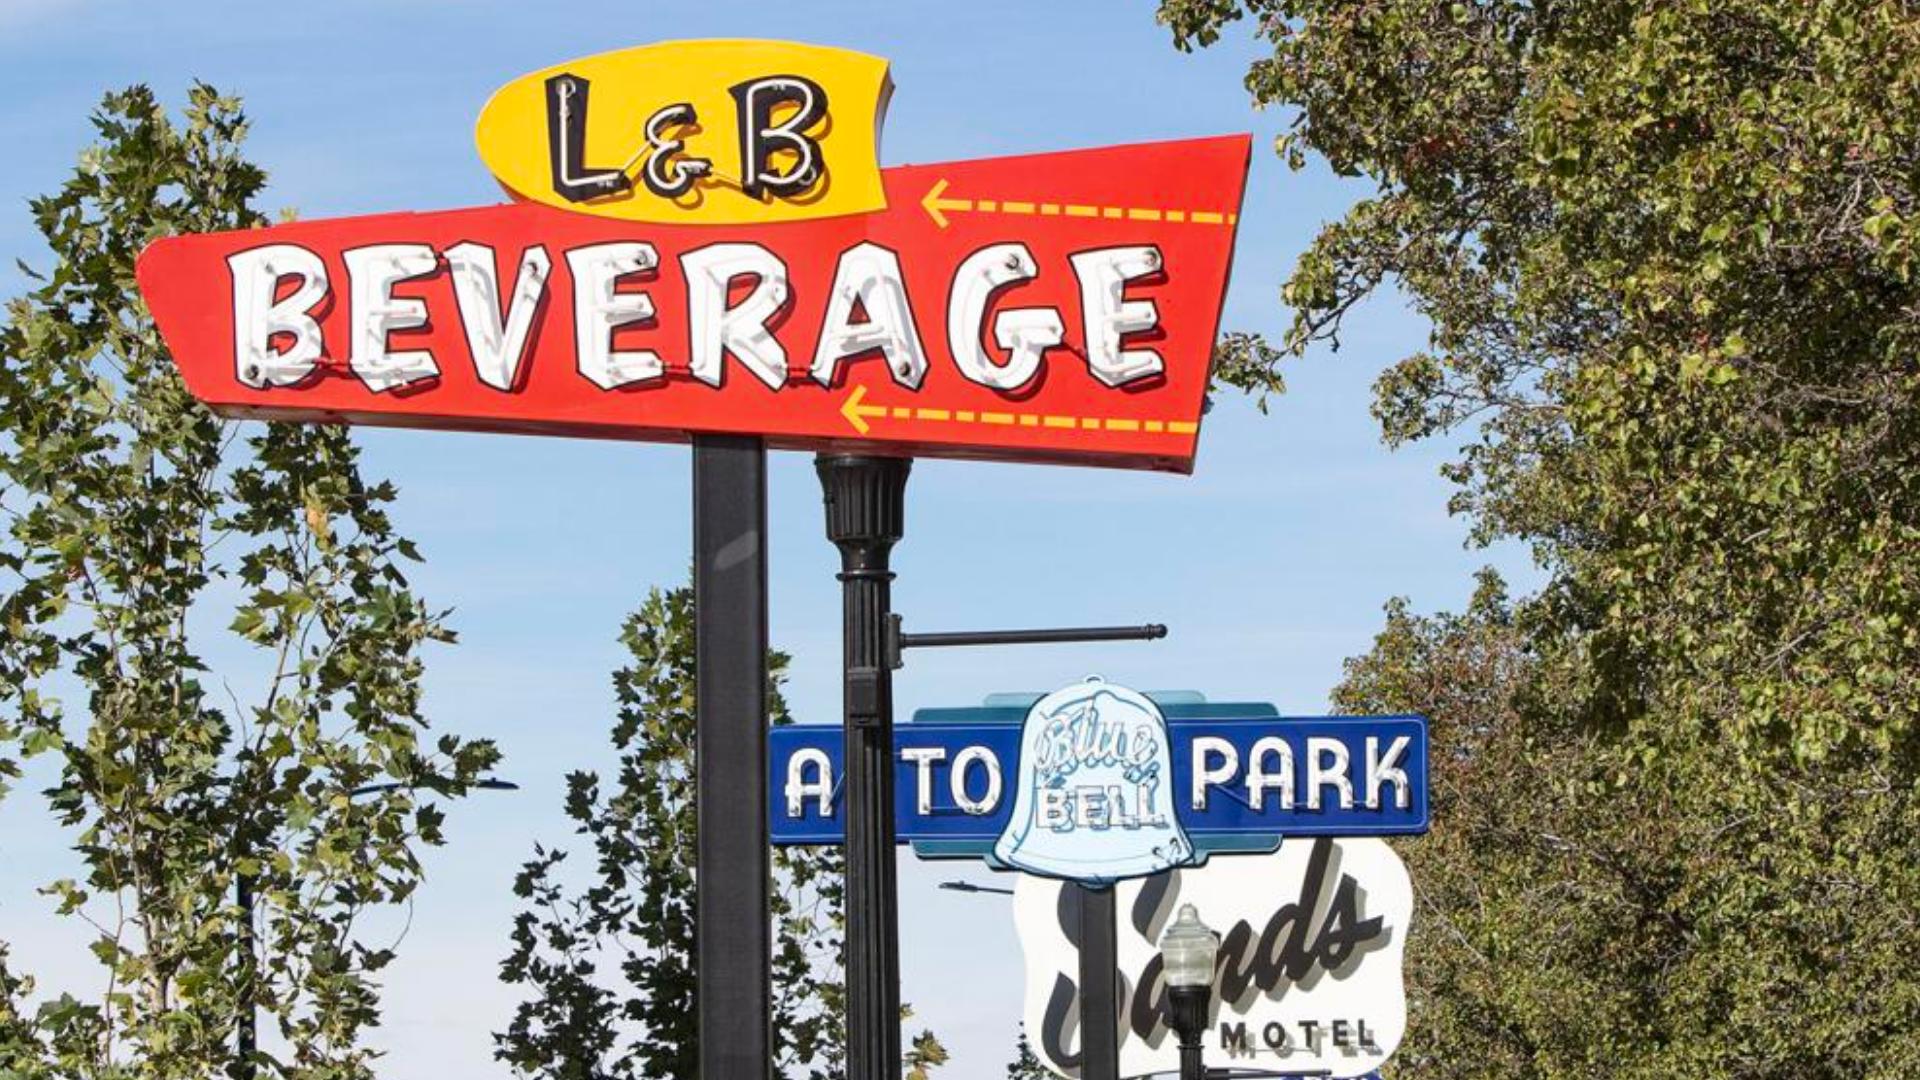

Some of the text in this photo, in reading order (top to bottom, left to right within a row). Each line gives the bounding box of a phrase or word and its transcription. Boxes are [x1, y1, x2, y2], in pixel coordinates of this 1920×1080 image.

[544, 72, 829, 203] L & B
[226, 239, 1165, 393] BEVERAGE
[1034, 699, 1155, 772] Blue
[784, 735, 1411, 818] ATO PARK
[1035, 785, 1166, 829] BELL
[1220, 1018, 1377, 1049] MOTEL
